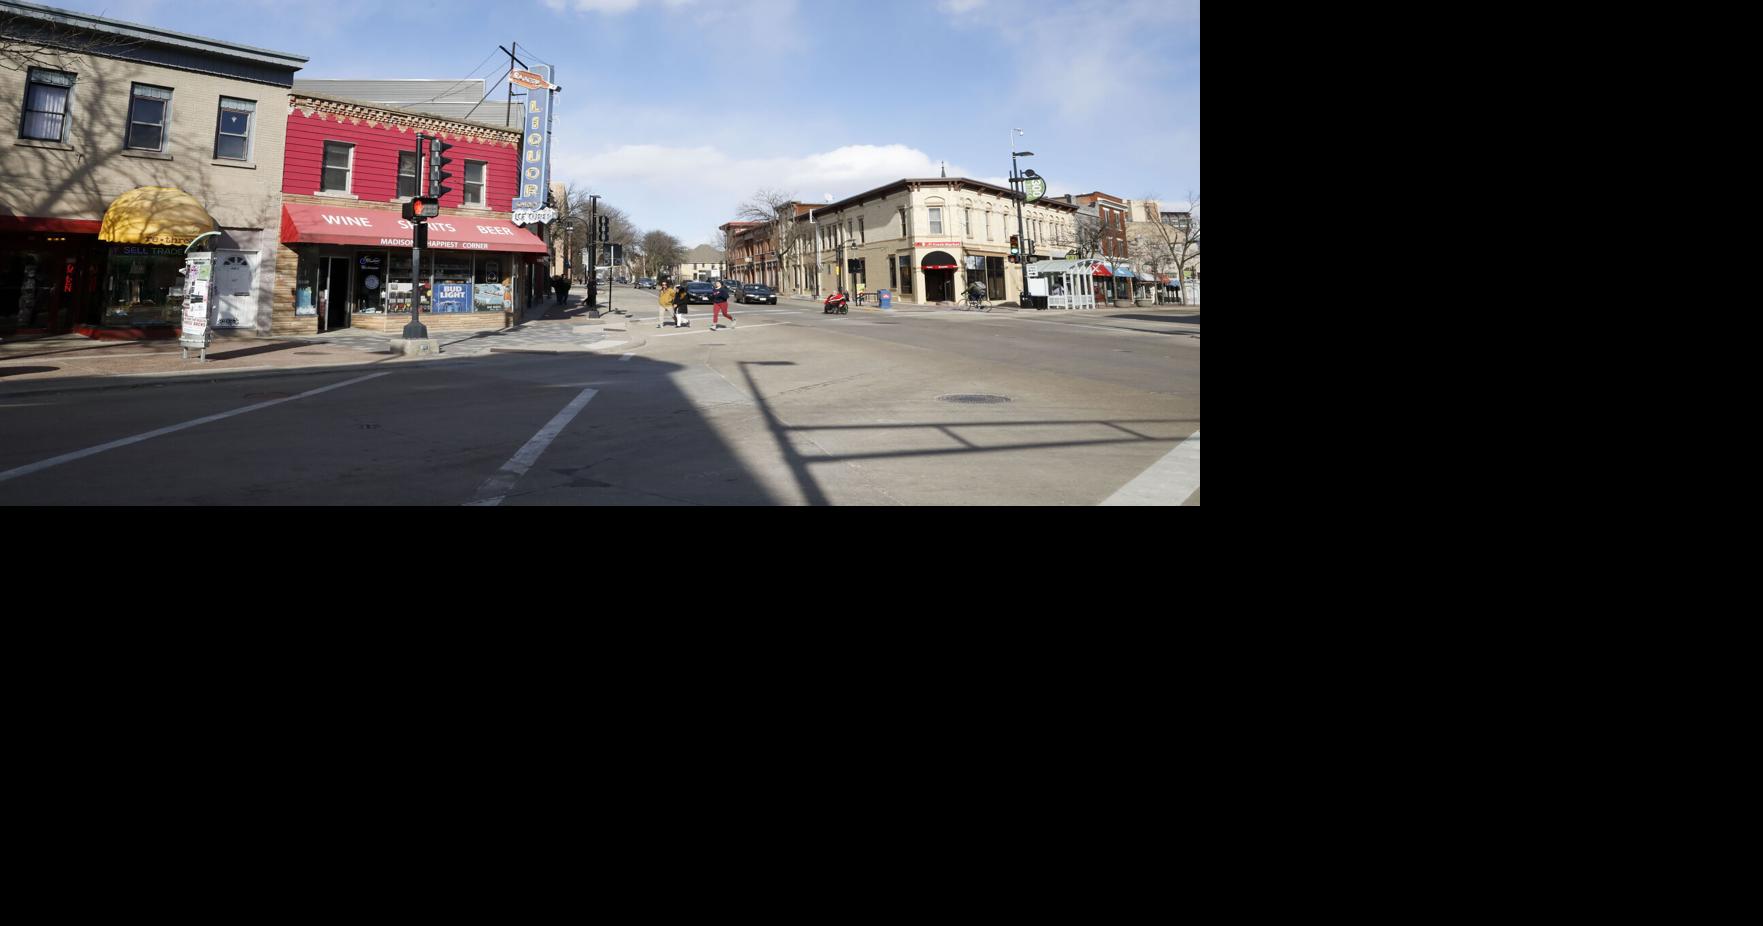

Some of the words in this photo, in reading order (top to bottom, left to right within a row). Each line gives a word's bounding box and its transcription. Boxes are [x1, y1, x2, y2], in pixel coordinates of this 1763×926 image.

[524, 100, 542, 198] LIQUOR
[321, 214, 373, 227] WINE
[398, 219, 456, 232] SPITS
[477, 225, 513, 236] BEER
[124, 246, 148, 255] SELL
[152, 247, 184, 256] TRADE
[427, 240, 459, 248] HAPPIEST
